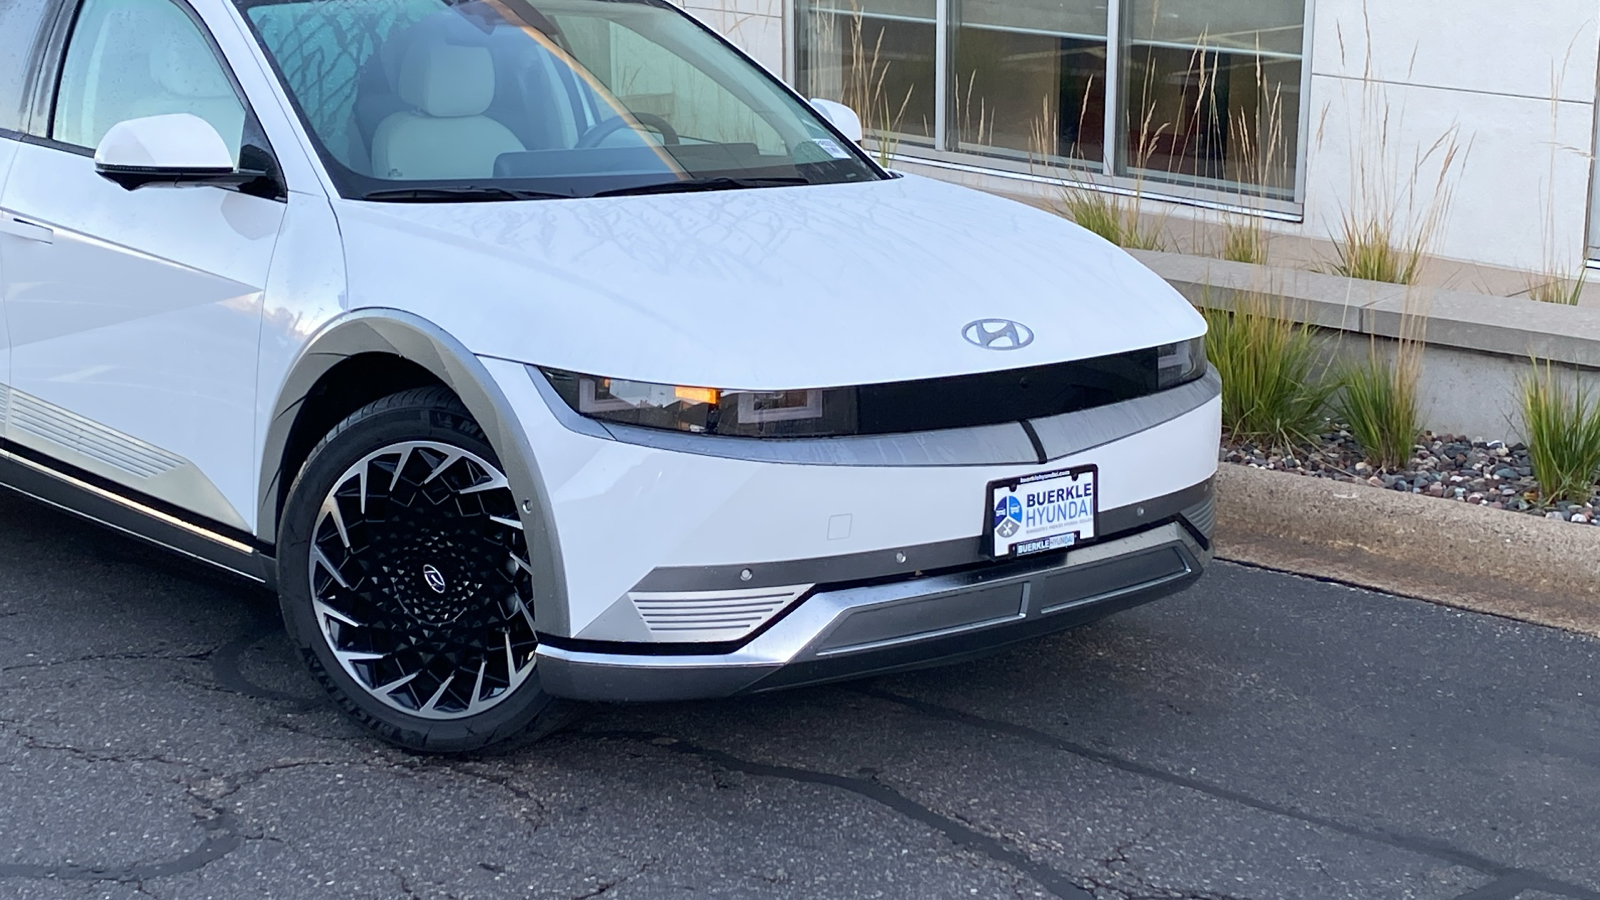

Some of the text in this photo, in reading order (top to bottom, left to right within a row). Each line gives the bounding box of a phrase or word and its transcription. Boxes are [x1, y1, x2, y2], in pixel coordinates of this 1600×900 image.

[1026, 483, 1092, 508] BUERKLE
[1026, 498, 1092, 528] HYUNDAI
[1018, 539, 1050, 554] BUERKLE
